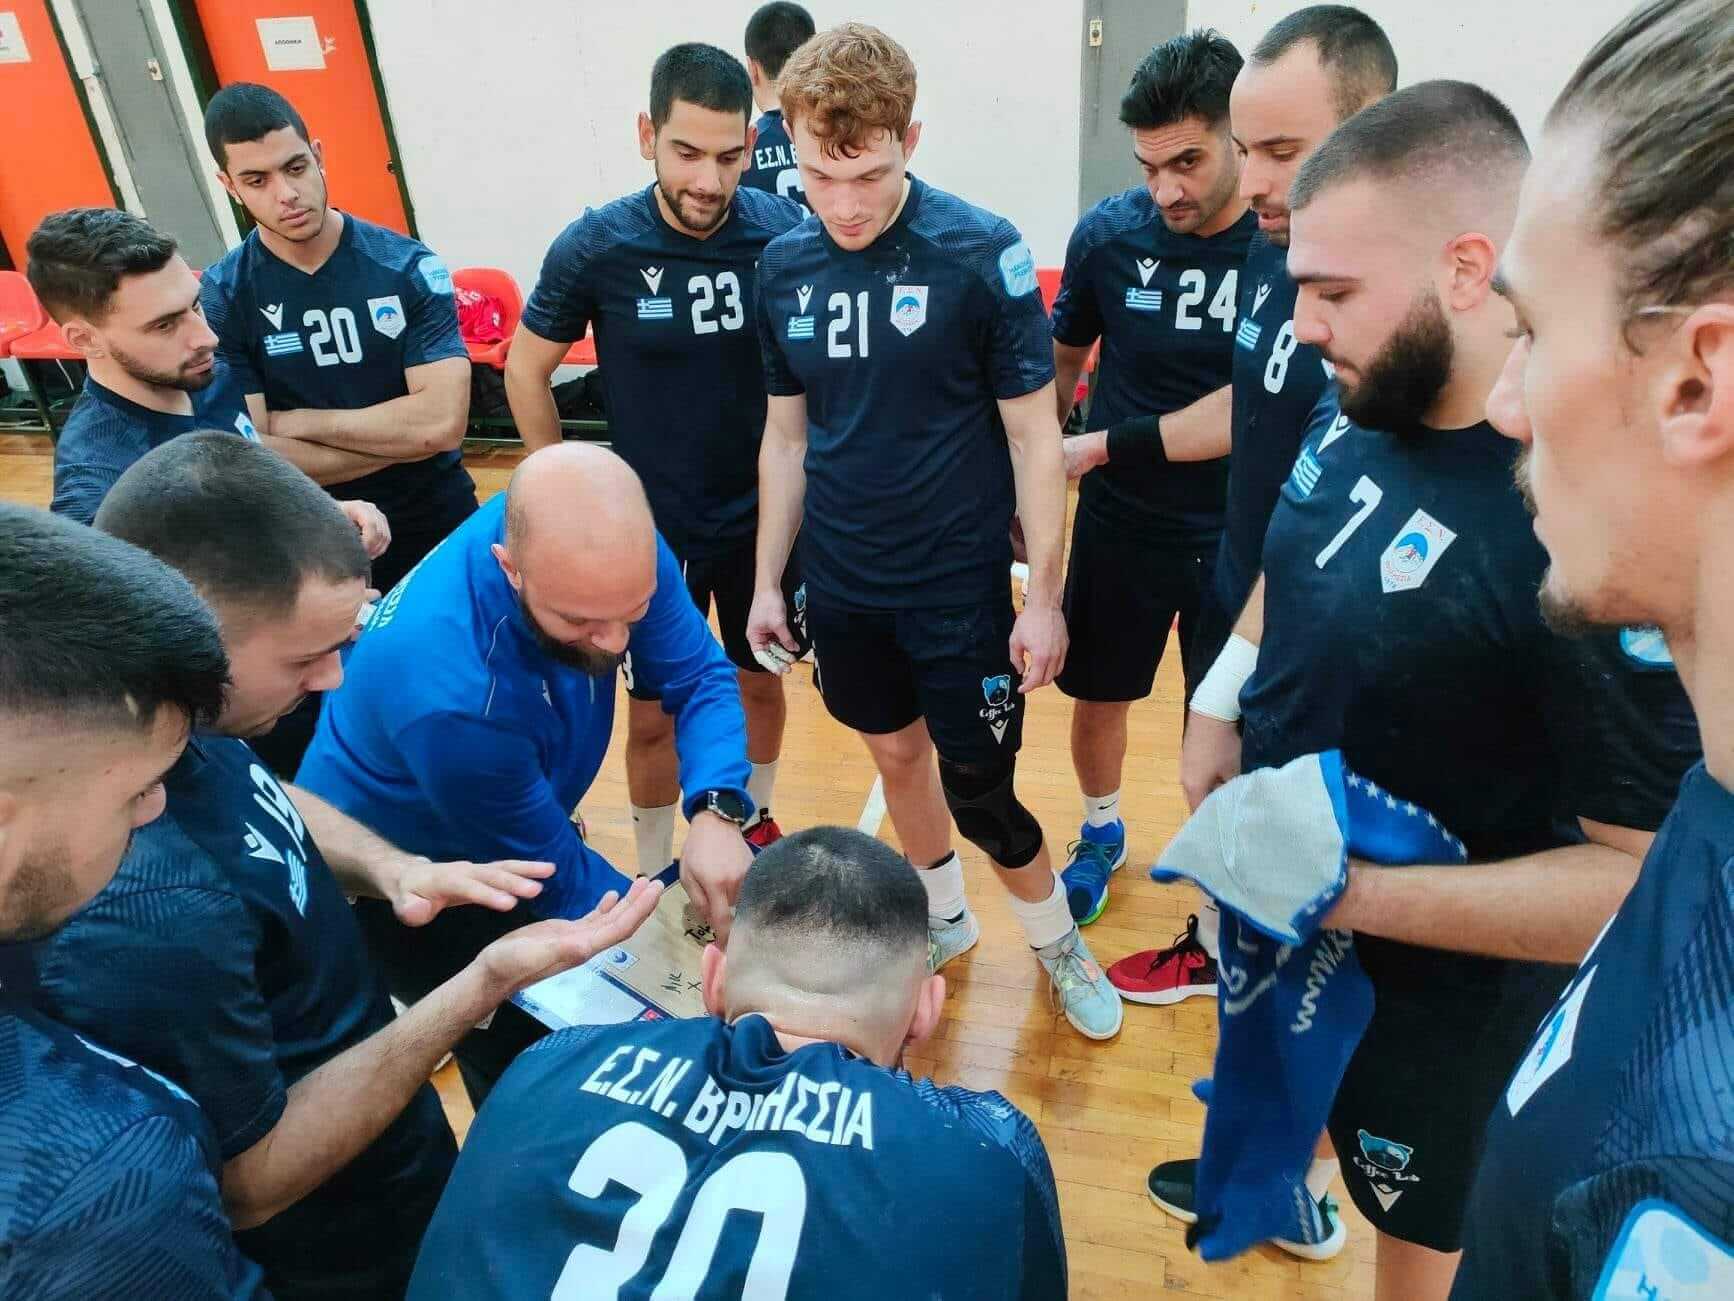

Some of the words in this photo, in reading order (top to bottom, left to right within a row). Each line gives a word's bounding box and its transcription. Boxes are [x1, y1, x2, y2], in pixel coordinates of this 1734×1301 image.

[687, 271, 744, 335] 23
[827, 291, 869, 358] 21
[1175, 269, 1239, 332] 24
[302, 307, 363, 367] 20
[1263, 319, 1299, 394] 8
[1315, 474, 1383, 569] 7
[579, 1045, 693, 1118] Ε.Σ.Ν.
